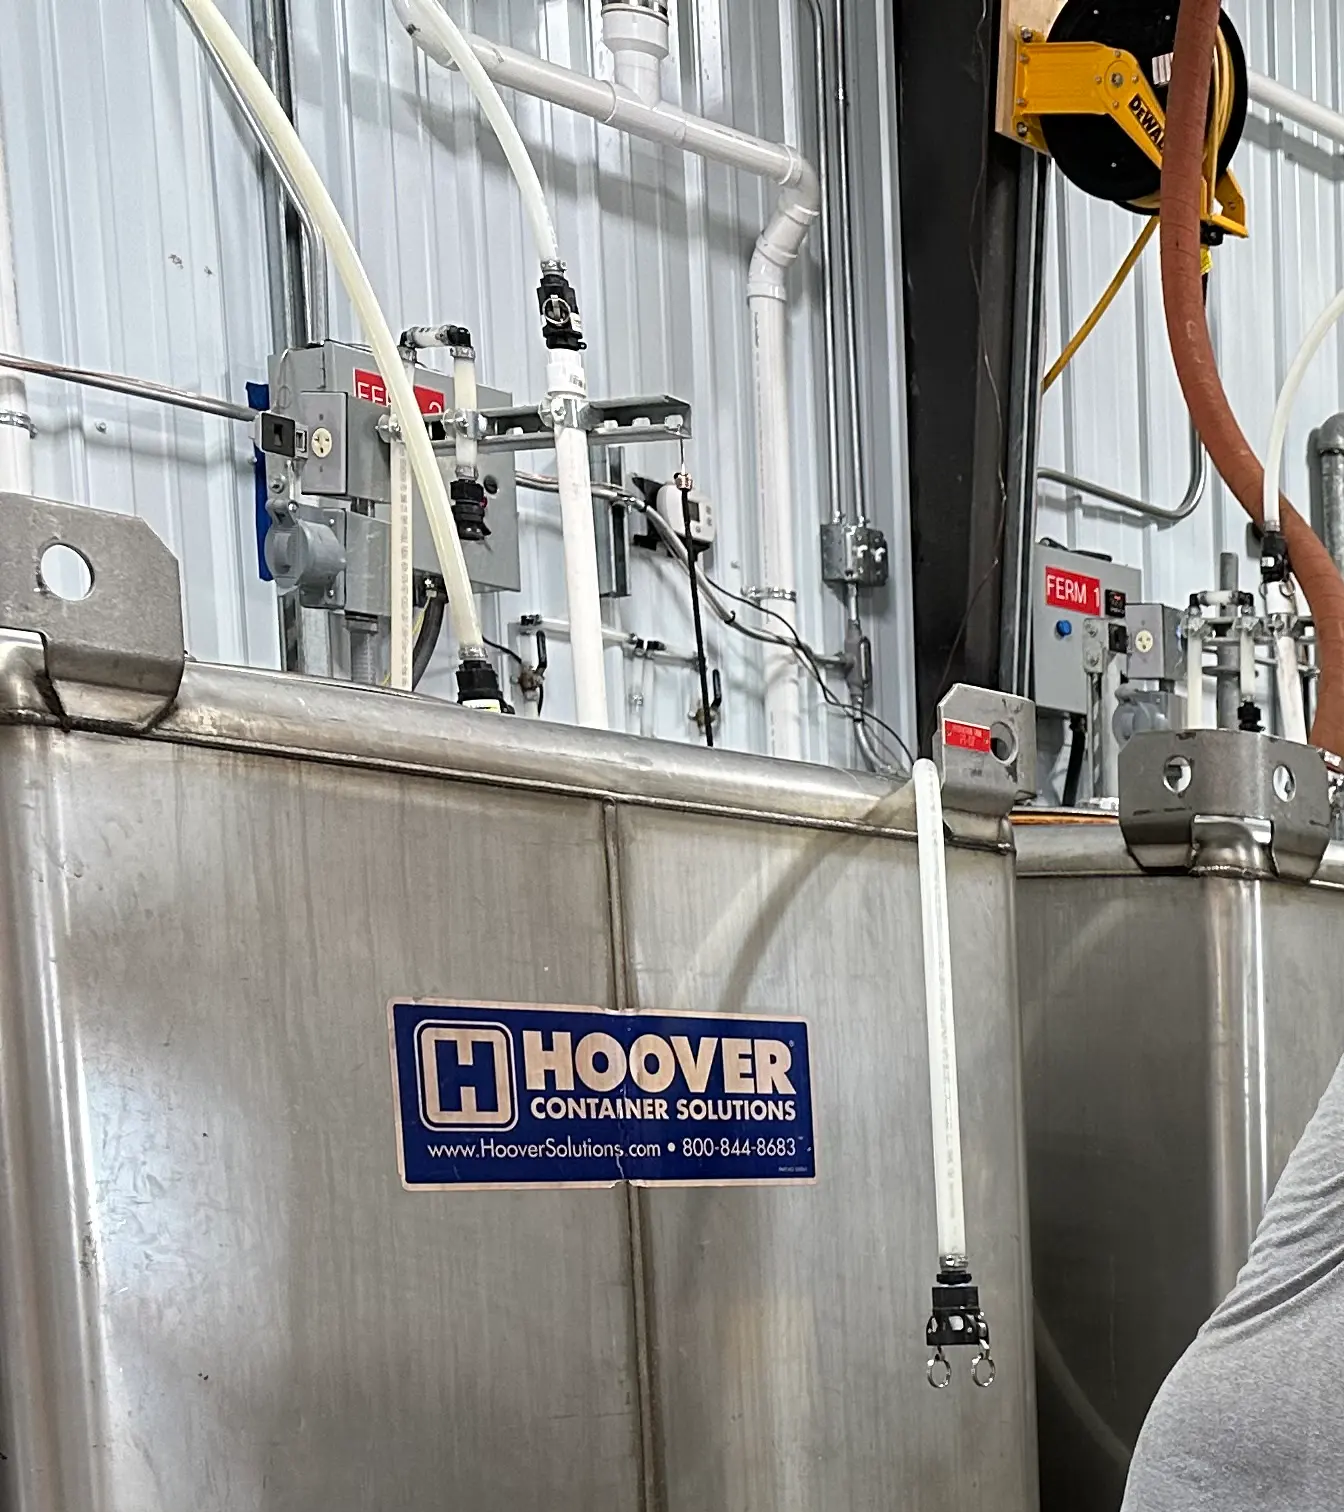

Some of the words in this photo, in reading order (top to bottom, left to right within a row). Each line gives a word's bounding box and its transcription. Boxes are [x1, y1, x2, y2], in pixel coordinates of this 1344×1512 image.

[1046, 573, 1088, 606] FERM
[1093, 587, 1101, 608] 1
[521, 1029, 798, 1096] HOOVER
[530, 1096, 670, 1121] CONTAINER
[676, 1098, 797, 1122] SOLUTIONS
[427, 1135, 662, 1159] www.HooverSolutions.com
[681, 1136, 797, 1158] 800-844-8683
